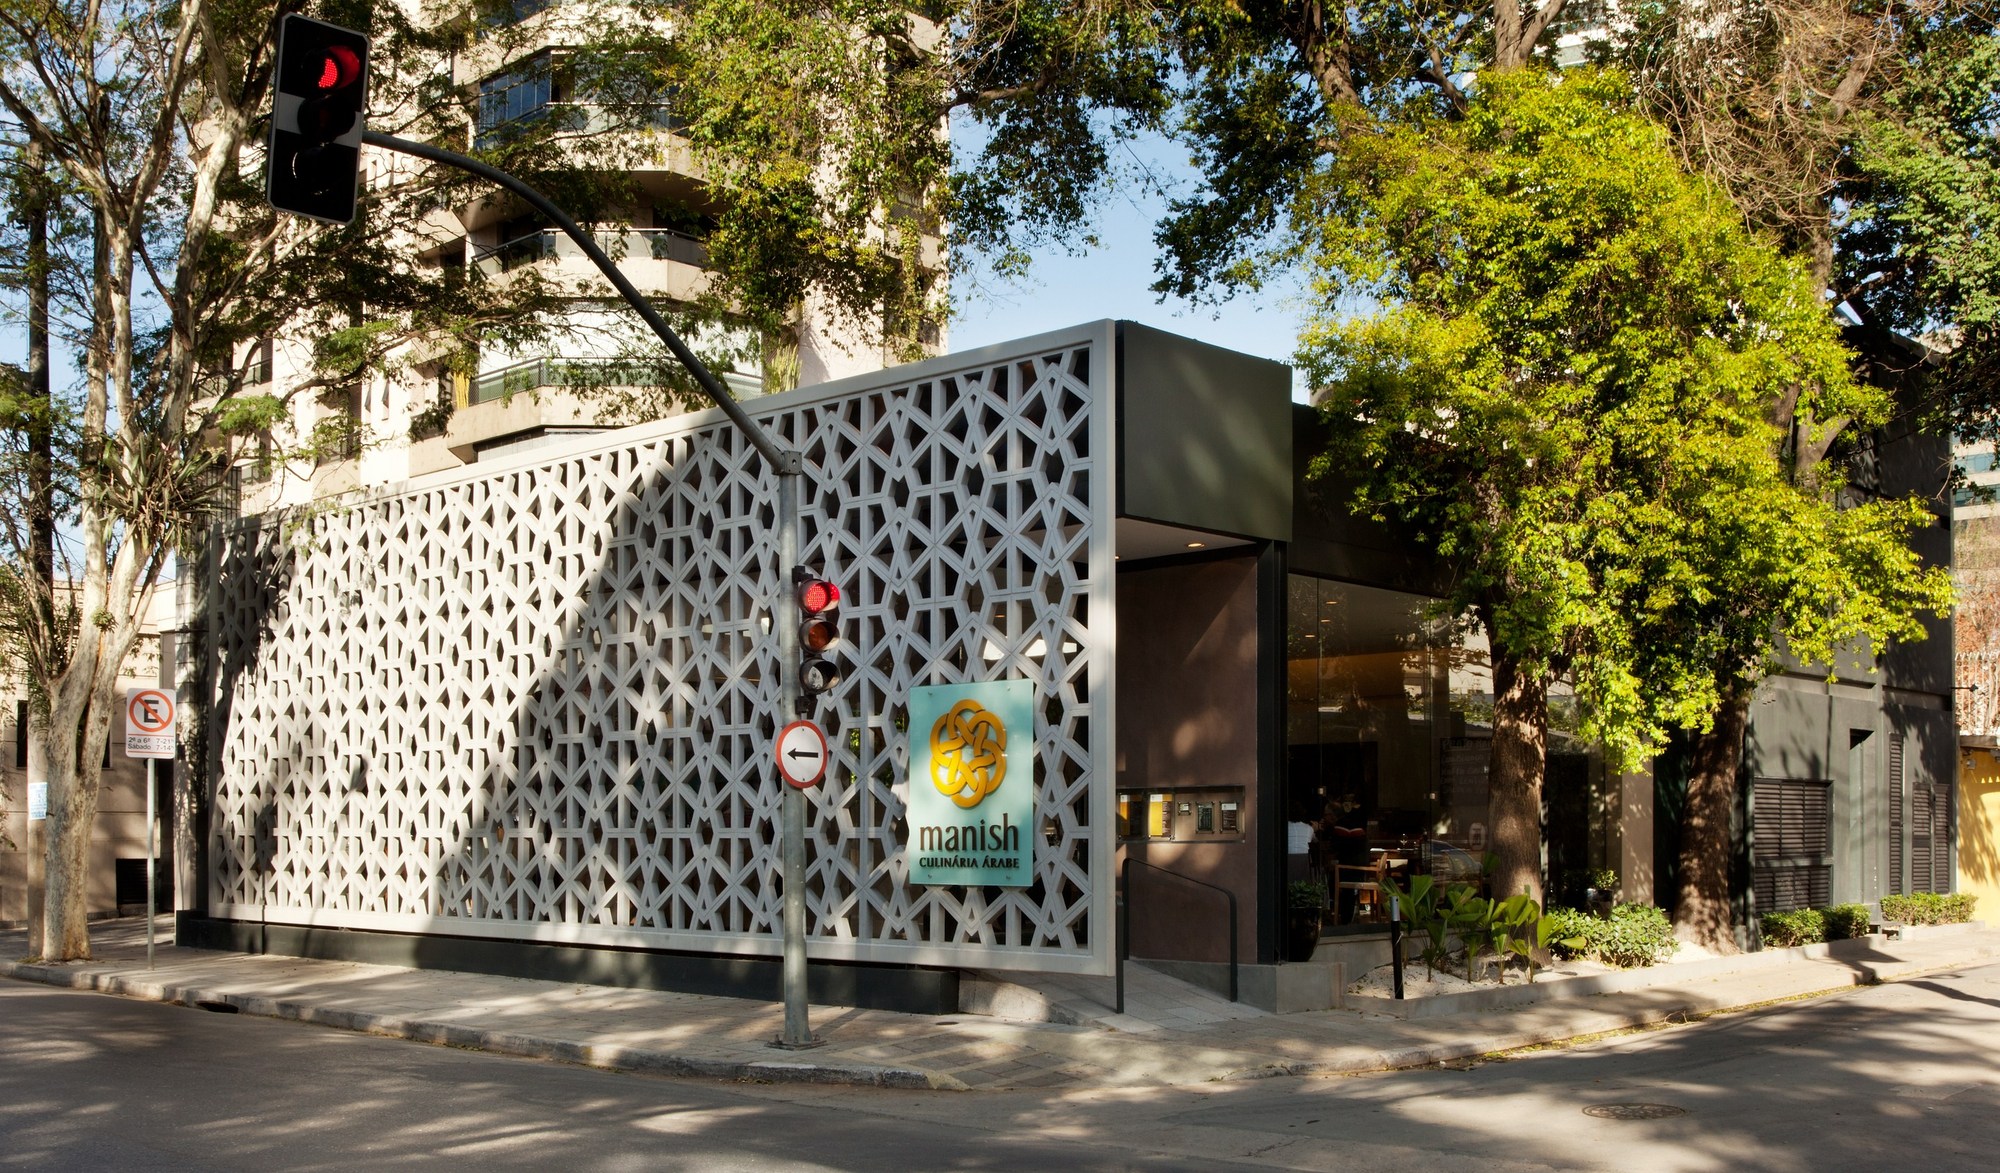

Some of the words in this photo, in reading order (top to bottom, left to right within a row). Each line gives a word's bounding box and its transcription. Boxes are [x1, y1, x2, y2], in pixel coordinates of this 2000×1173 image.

[144, 699, 159, 723] E
[919, 813, 1019, 851] manish
[919, 855, 978, 868] CULINÁRIA
[982, 855, 1019, 868] ÁRABE
